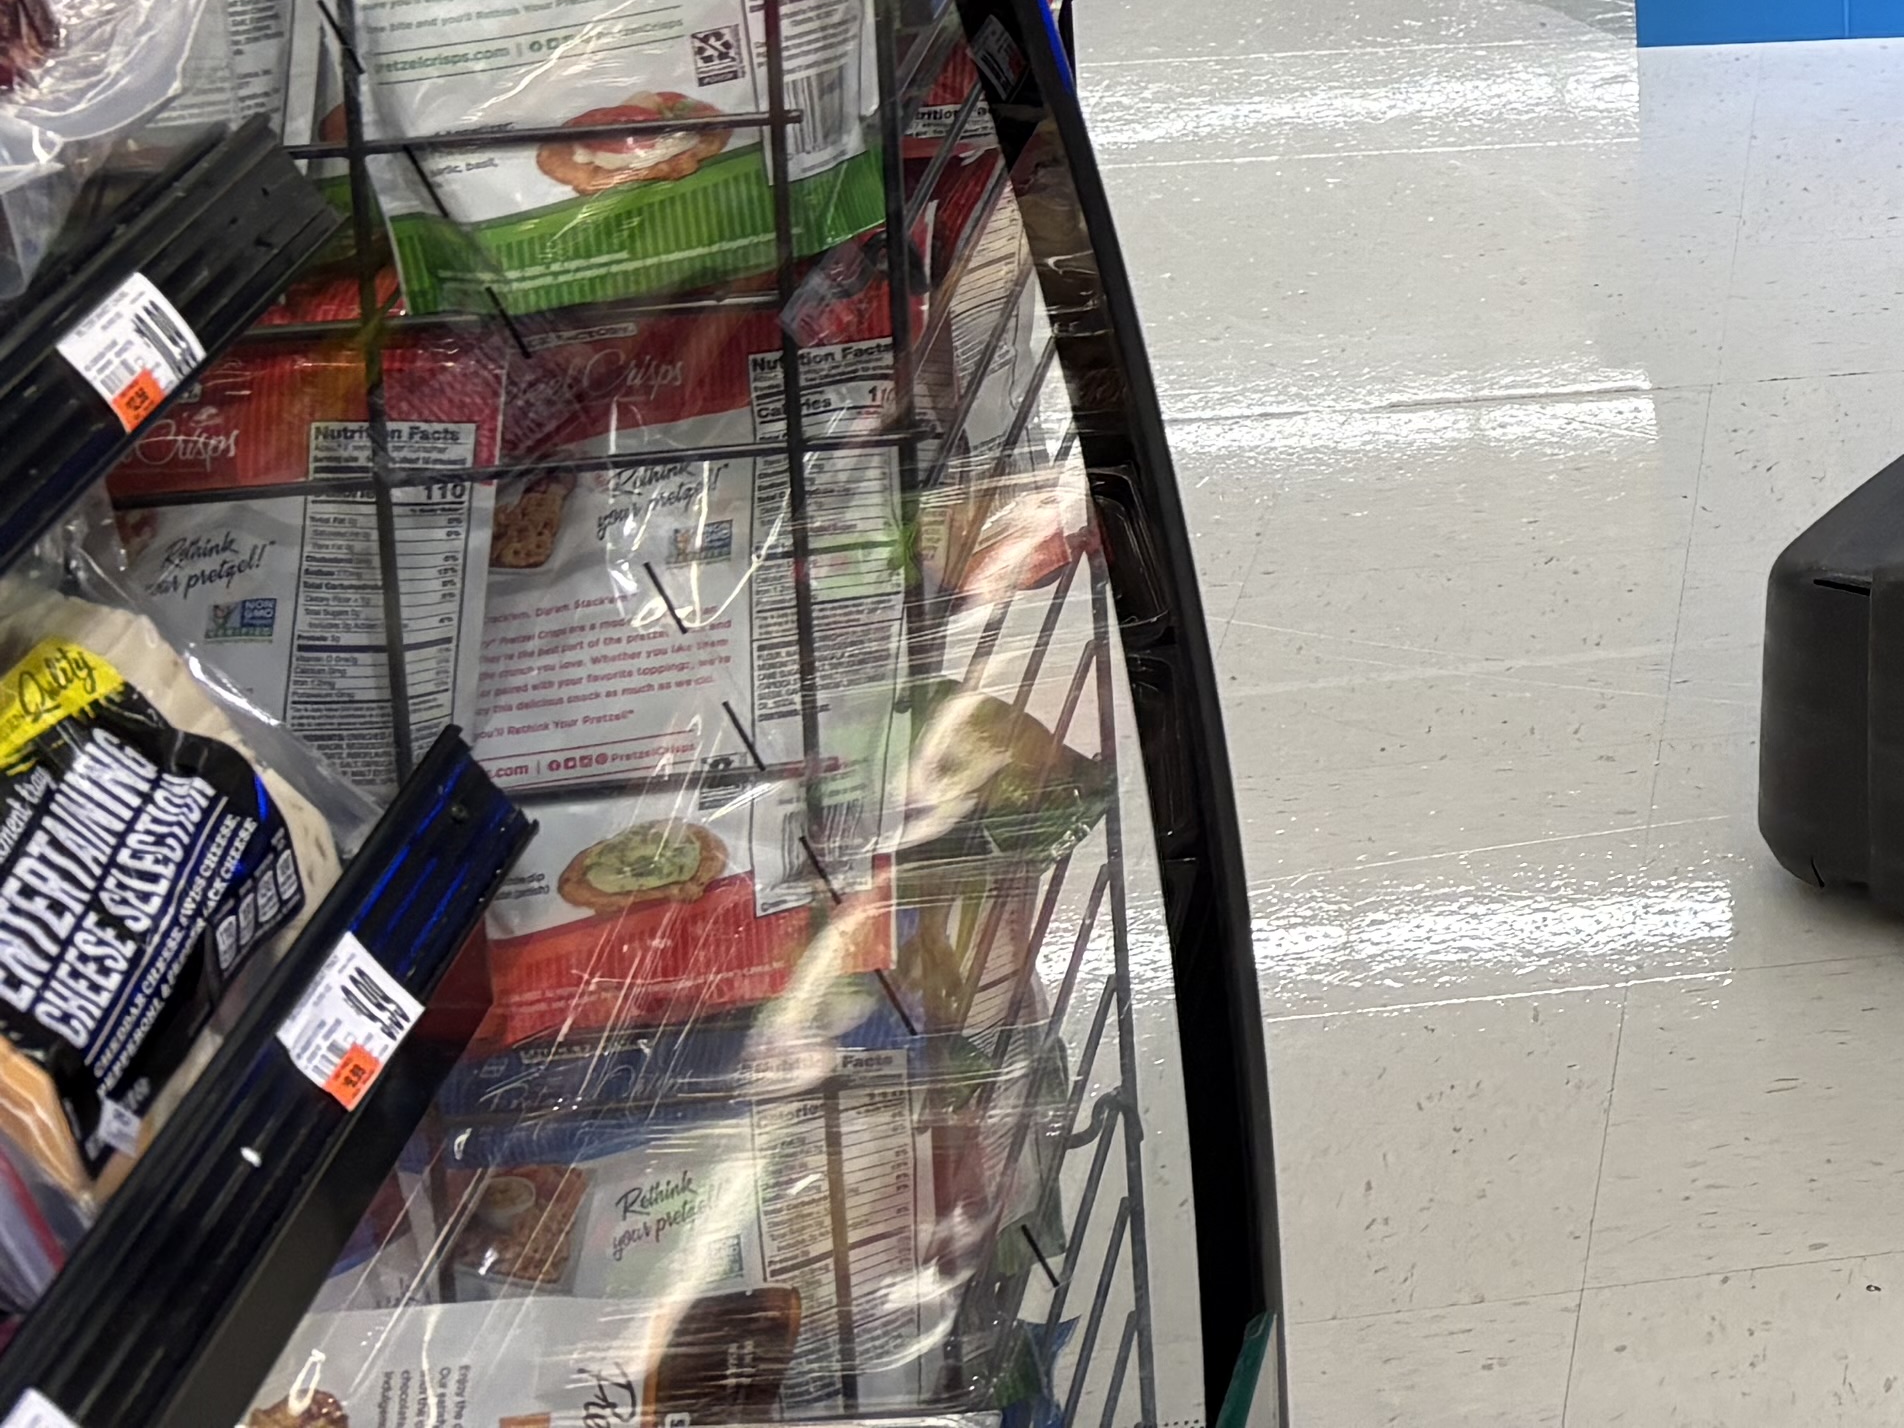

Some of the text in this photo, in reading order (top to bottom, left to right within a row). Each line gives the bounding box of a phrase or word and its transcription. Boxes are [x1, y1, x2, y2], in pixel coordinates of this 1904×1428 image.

[408, 427, 460, 442] Facts
[0, 727, 158, 1012] ENTERTAINING
[35, 772, 217, 1047] CHEESE SELECTION
[615, 1169, 698, 1222] Rethink
